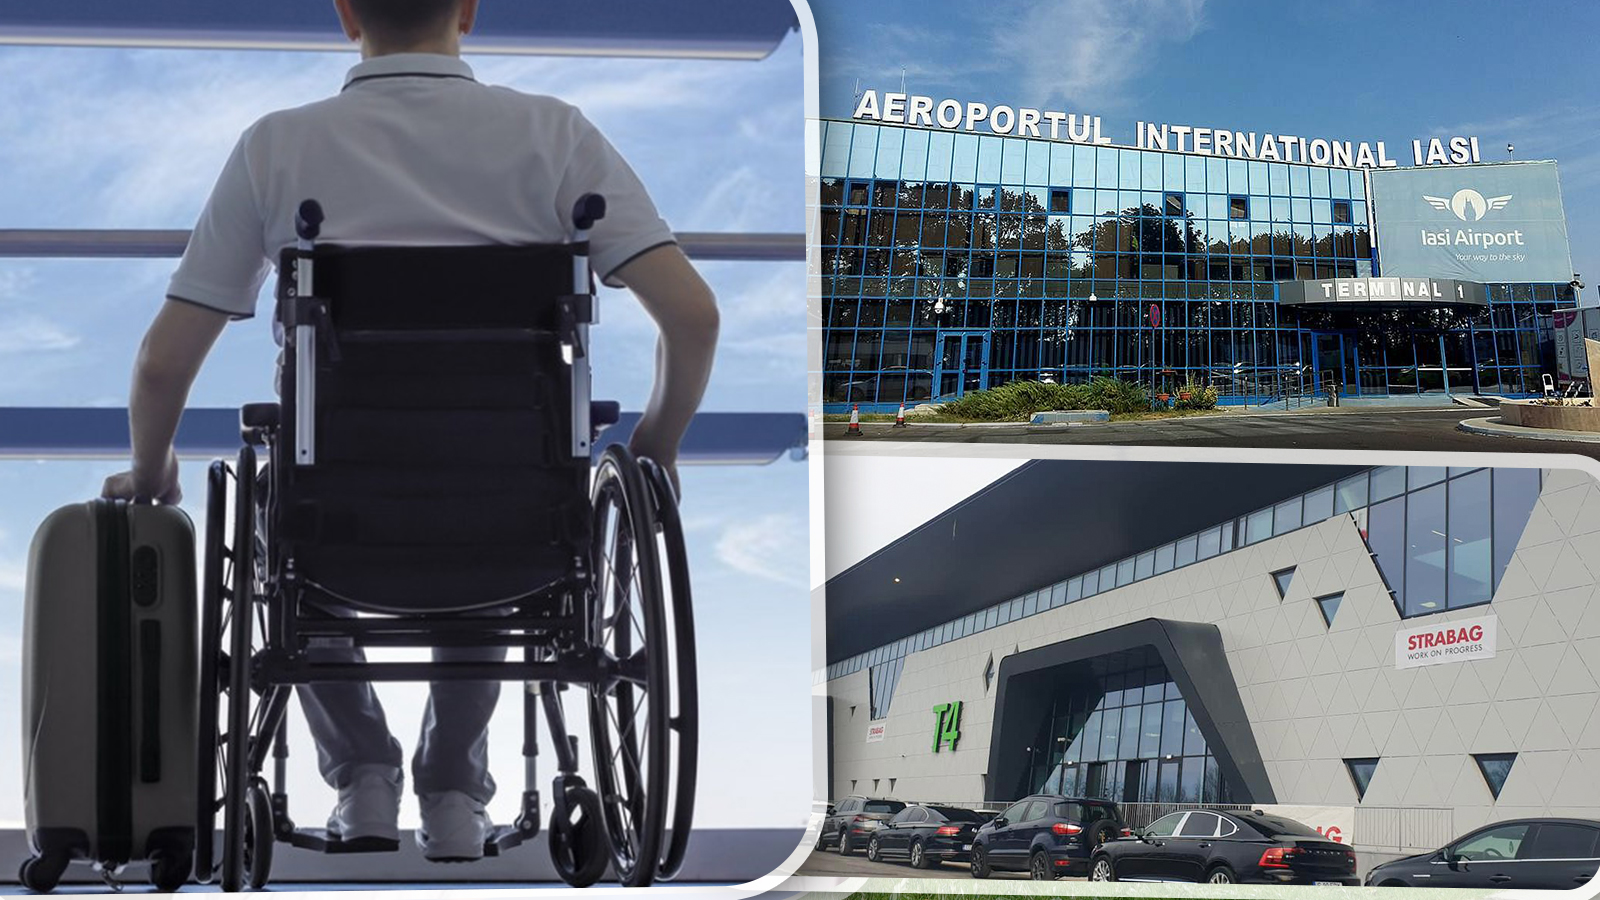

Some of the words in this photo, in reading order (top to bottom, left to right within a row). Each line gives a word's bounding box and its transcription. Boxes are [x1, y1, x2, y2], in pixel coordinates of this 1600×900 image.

[853, 89, 1112, 145] AEROPORTUL
[1135, 121, 1397, 169] INTERNATIONAL
[1412, 136, 1481, 166] IASI
[1421, 229, 1451, 246] Iasi
[1454, 229, 1525, 249] Airport
[1455, 253, 1472, 261] Your
[1489, 253, 1498, 261] to
[1499, 253, 1511, 261] the
[1512, 253, 1526, 262] sky
[1321, 281, 1442, 298] TERMINAL
[1457, 284, 1465, 298] 1
[1408, 625, 1484, 650] STRABAG
[1407, 651, 1429, 660] WORK
[1430, 649, 1442, 658] ON
[1445, 644, 1483, 656] PROGRESS
[932, 700, 963, 753] T4
